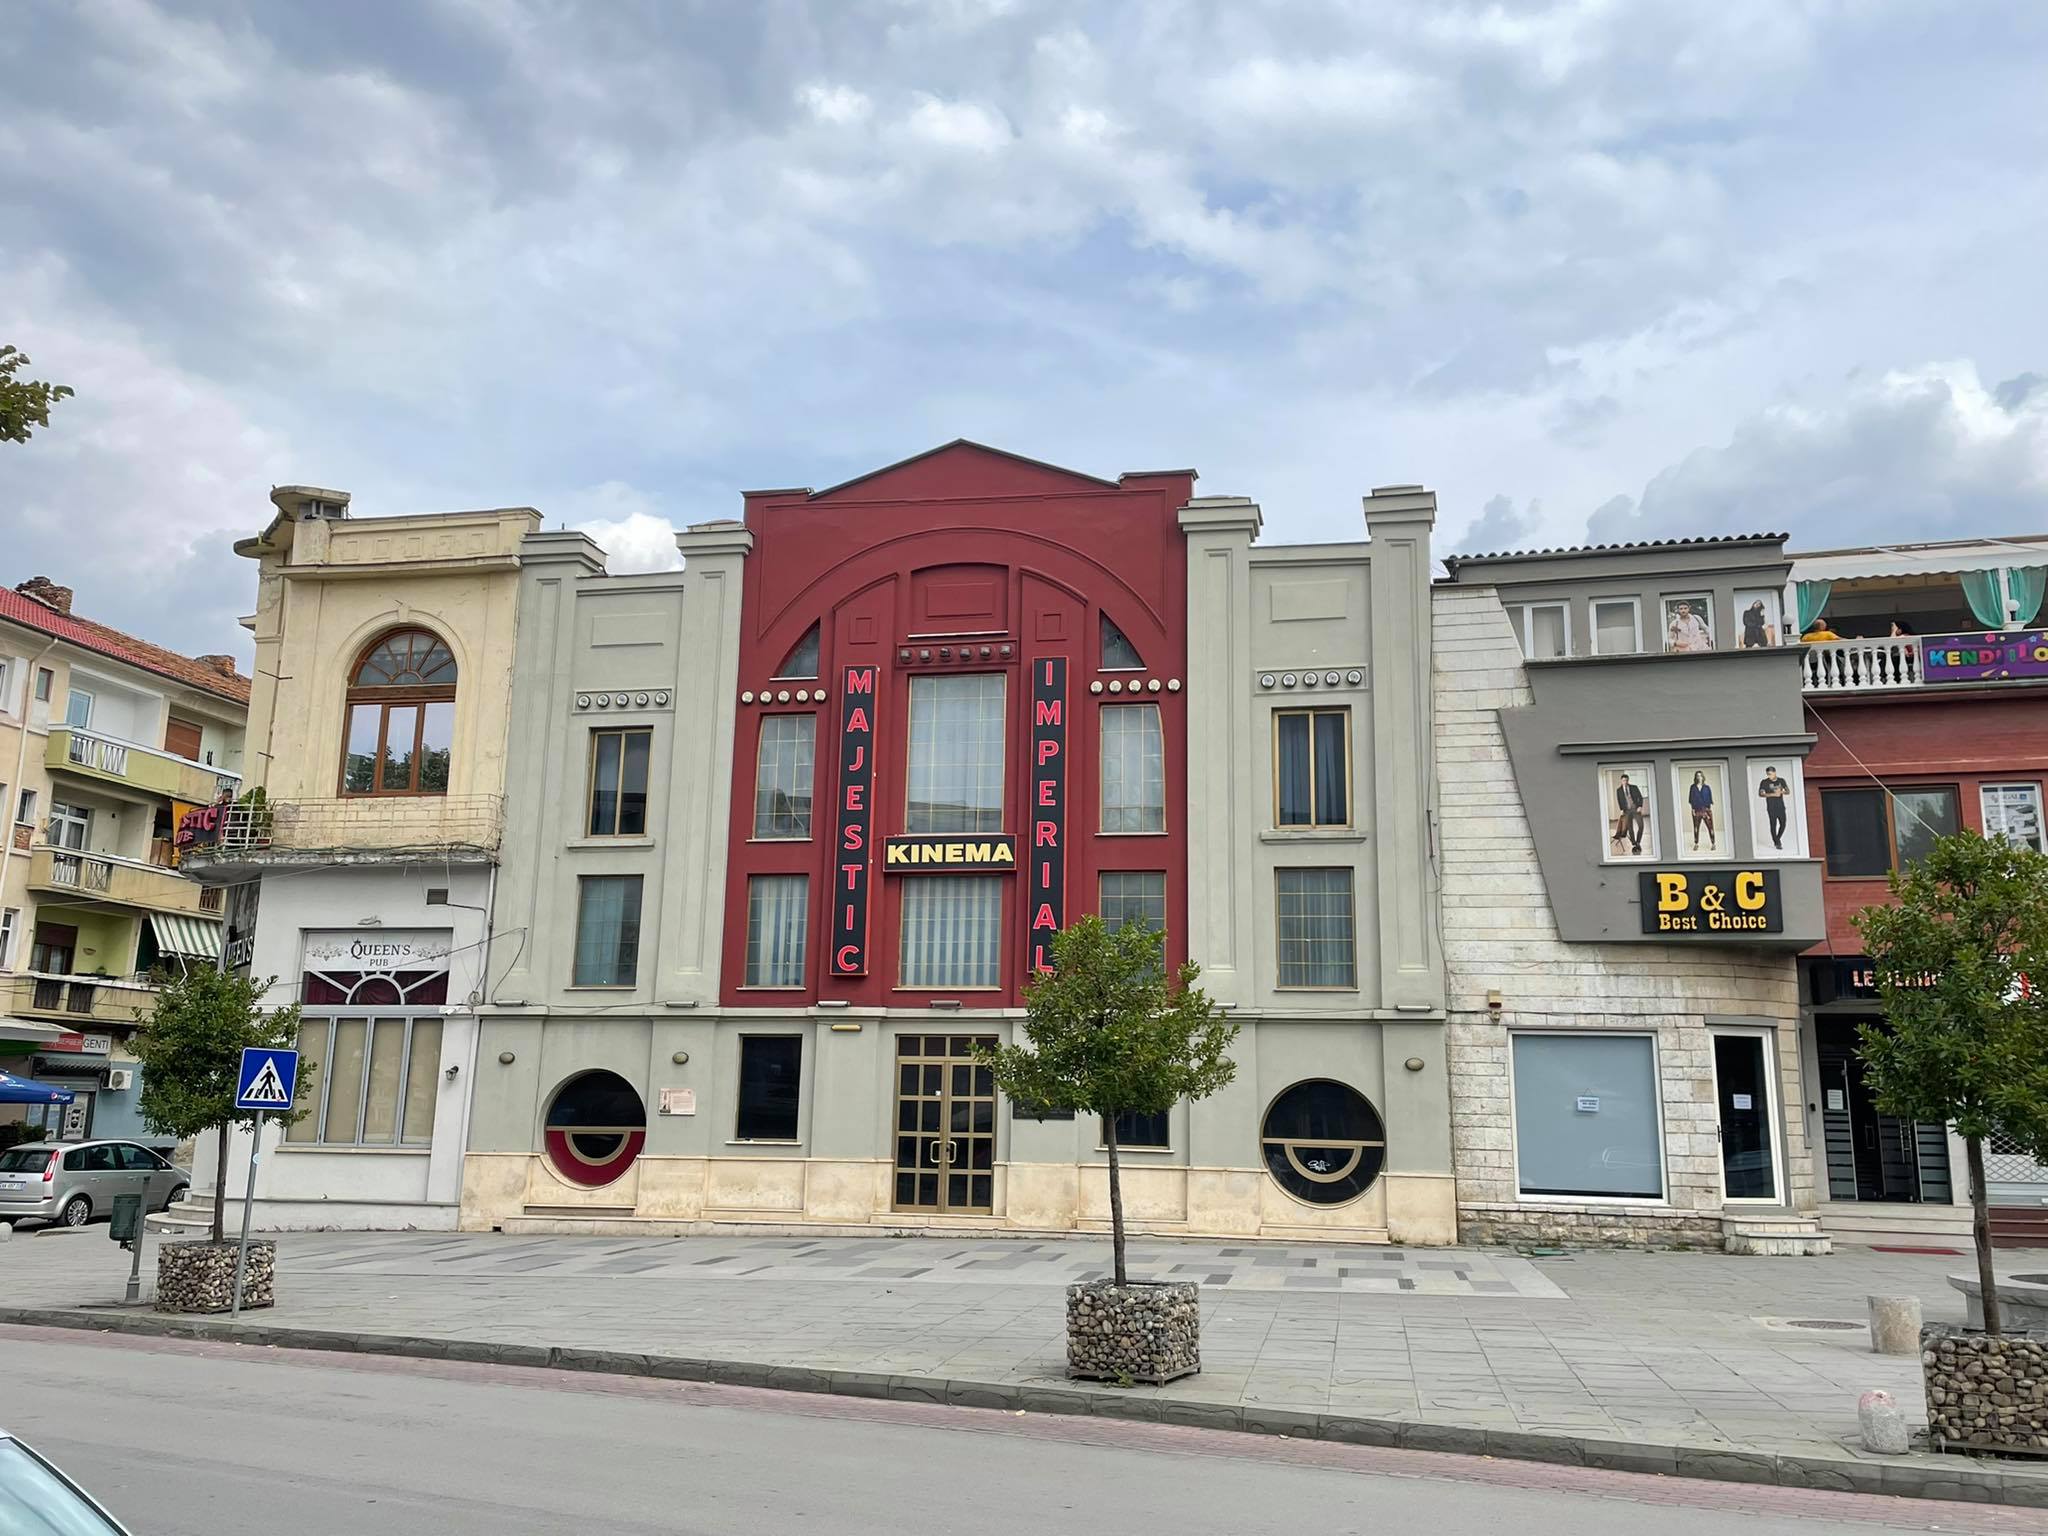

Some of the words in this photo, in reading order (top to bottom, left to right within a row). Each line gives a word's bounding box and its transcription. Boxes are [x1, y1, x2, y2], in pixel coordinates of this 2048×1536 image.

[836, 669, 872, 972] MAJESTIC
[1032, 660, 1062, 973] IMPERIAL
[887, 843, 1014, 863] KINEMA
[1656, 873, 1689, 911] B
[1700, 885, 1725, 911] &
[1735, 871, 1766, 910] C
[1659, 913, 1698, 930] Best
[1708, 911, 1767, 929] Choice
[350, 941, 411, 960] QUEEN'S
[369, 958, 389, 967] PUB
[83, 1038, 109, 1050] GENTI
